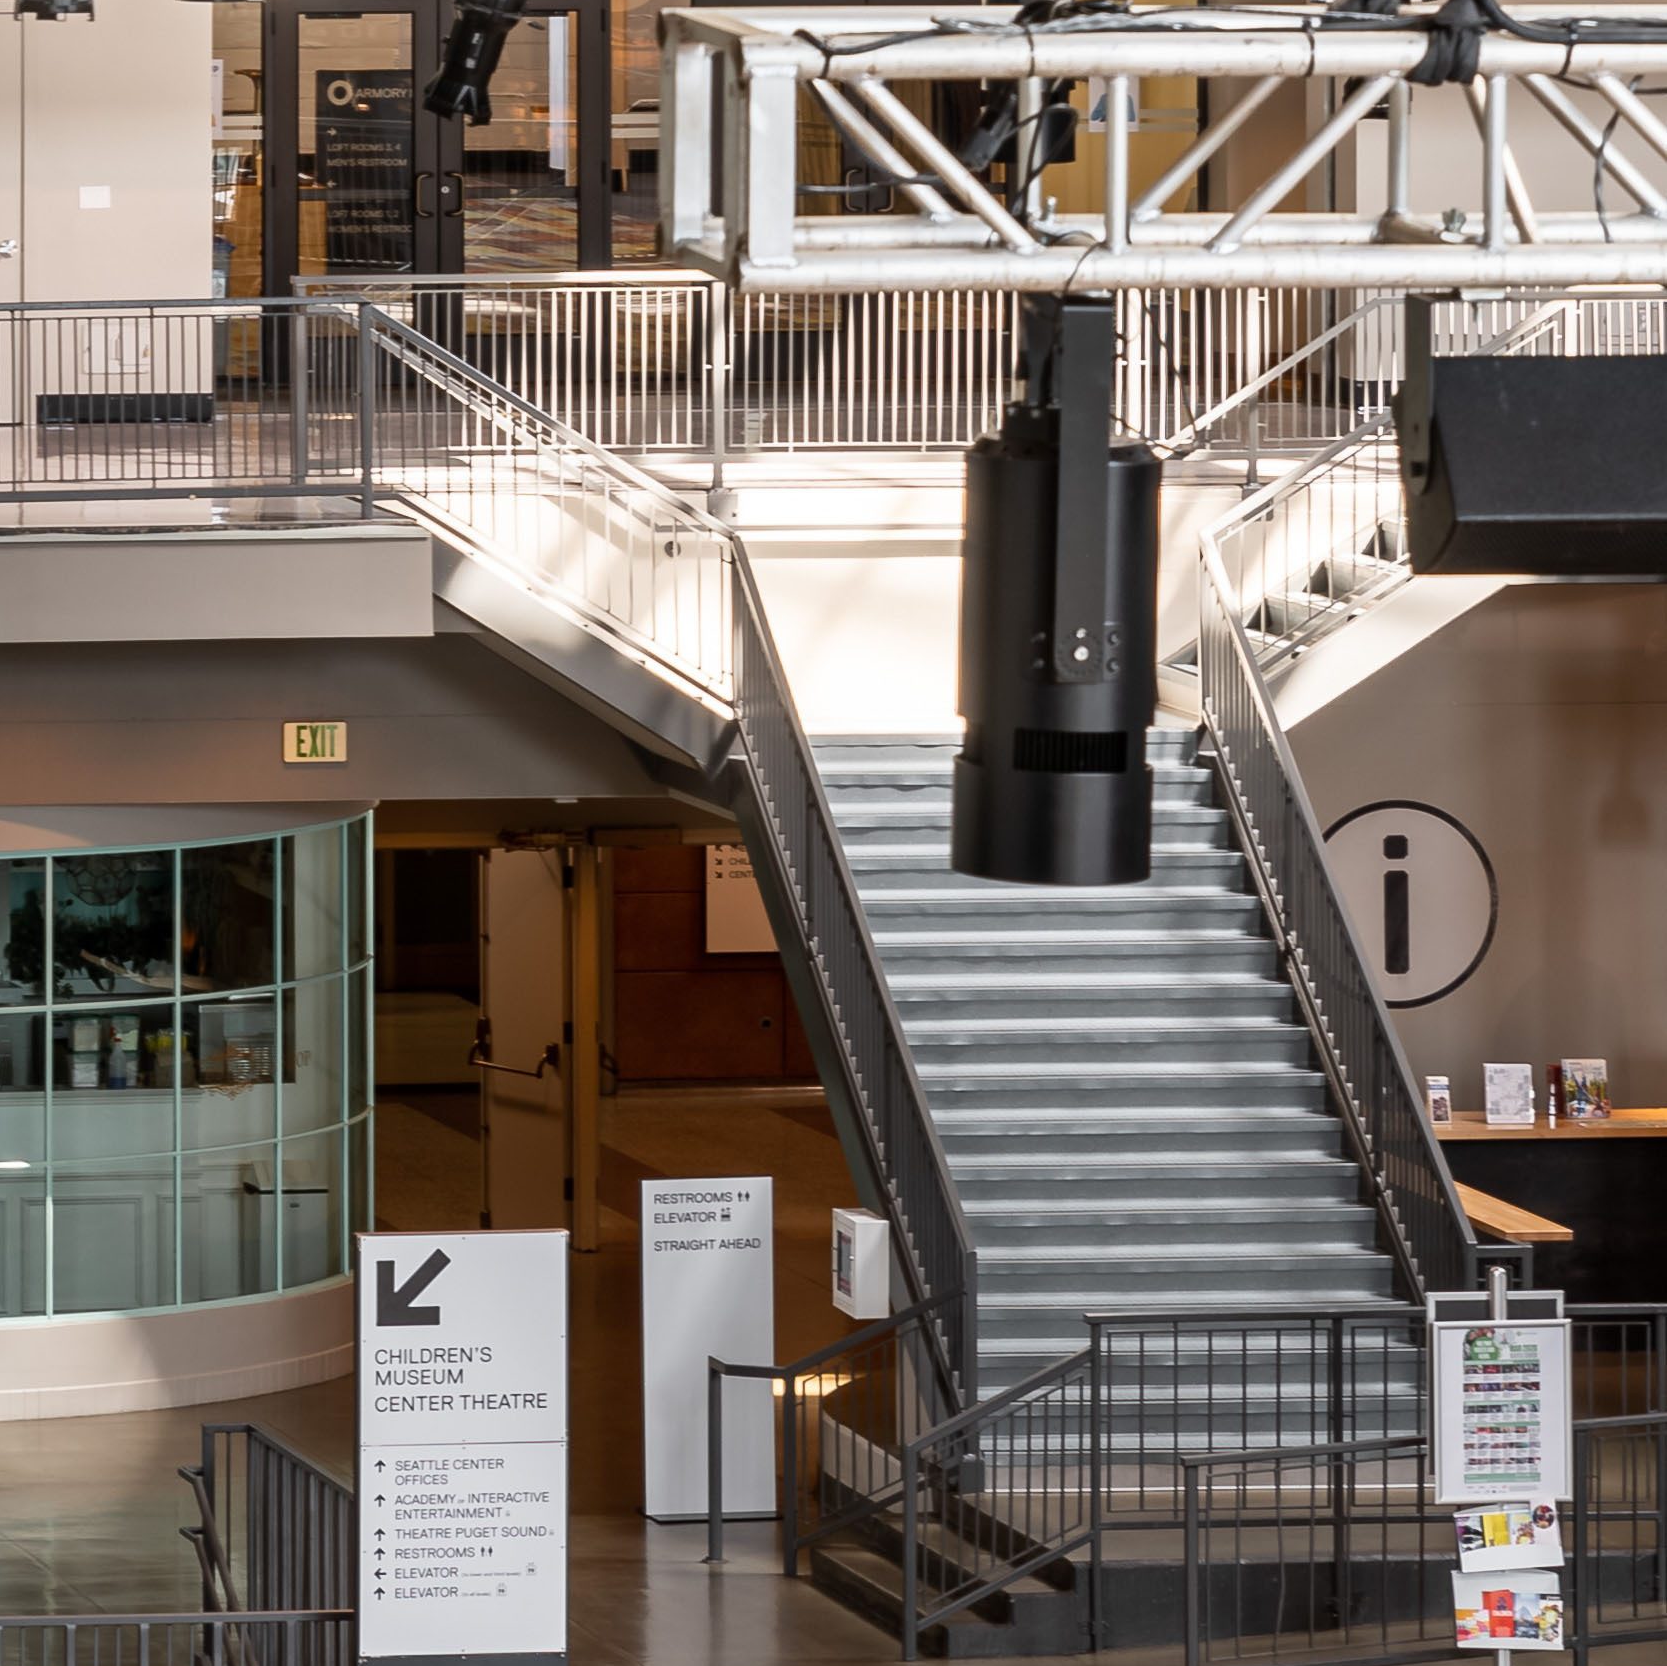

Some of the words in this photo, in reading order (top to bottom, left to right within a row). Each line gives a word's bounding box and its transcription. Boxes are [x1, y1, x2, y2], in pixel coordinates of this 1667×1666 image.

[354, 88, 407, 99] ARMORY
[357, 158, 407, 167] RESTROOM
[296, 724, 338, 758] EXIT
[654, 1191, 733, 1205] RESTROOMS
[654, 1211, 716, 1224] ELEVATOR
[654, 1239, 716, 1252] STRAIGHT
[718, 1237, 762, 1250] AHEAD
[374, 1346, 492, 1365] CHILDREN'S
[375, 1368, 464, 1386] MUSEUM
[374, 1395, 454, 1413] CENTER
[459, 1392, 548, 1410] THEATRE
[394, 1459, 449, 1471] SEATTLE
[452, 1458, 505, 1470] CENTER
[394, 1474, 449, 1486] OFFICES
[394, 1494, 456, 1506] ACADEMY
[467, 1491, 550, 1504] INTERACTIVE
[394, 1507, 503, 1520] ENTERTAINMENT
[394, 1527, 452, 1540] THEATRE
[455, 1526, 498, 1539] PUGET
[500, 1525, 547, 1538] SOUND
[394, 1547, 476, 1560] RESTROOMS
[394, 1567, 459, 1579] ELEVATOR
[394, 1586, 459, 1599] ELEVATOR
